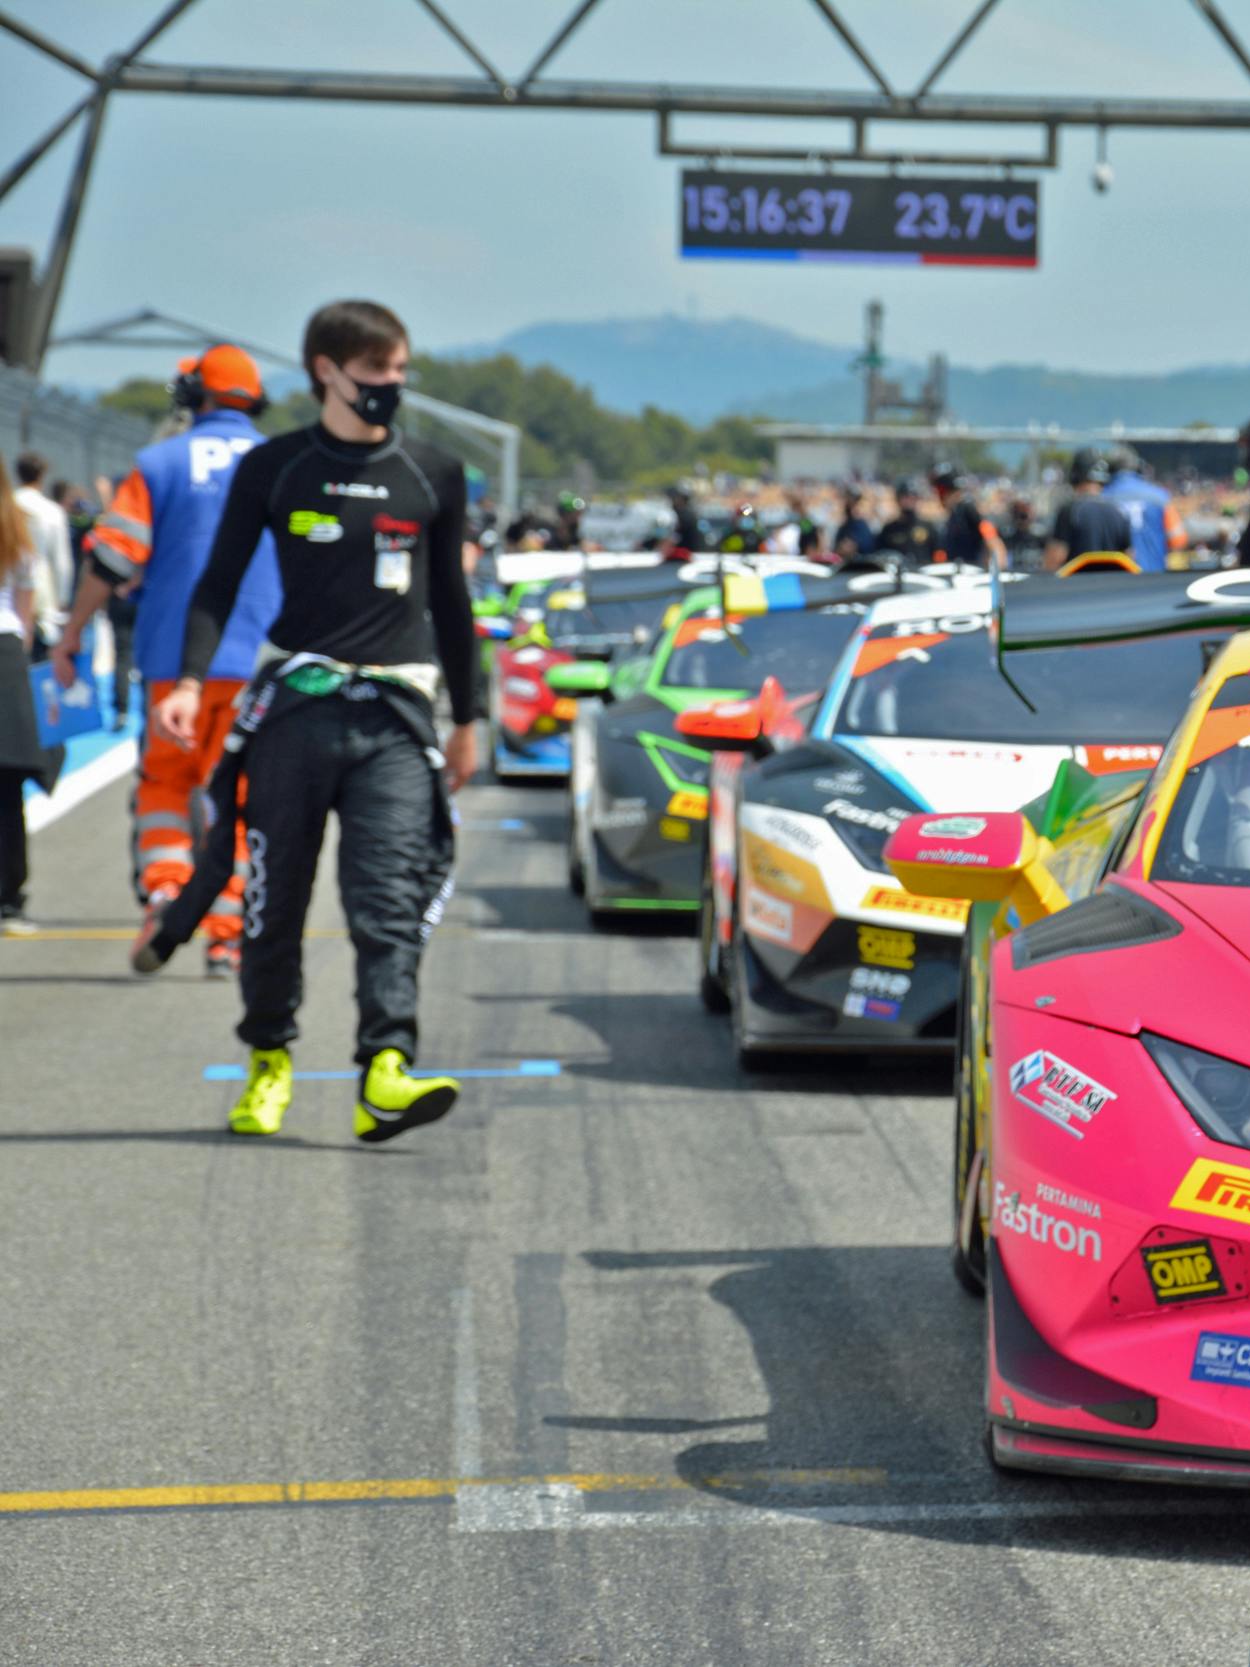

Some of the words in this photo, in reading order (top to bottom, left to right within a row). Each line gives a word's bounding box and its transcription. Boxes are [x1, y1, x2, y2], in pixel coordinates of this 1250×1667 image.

[684, 186, 851, 234] 15:16:37
[1036, 1182, 1102, 1219] PERTAMINA
[1151, 1254, 1213, 1288] OMP
